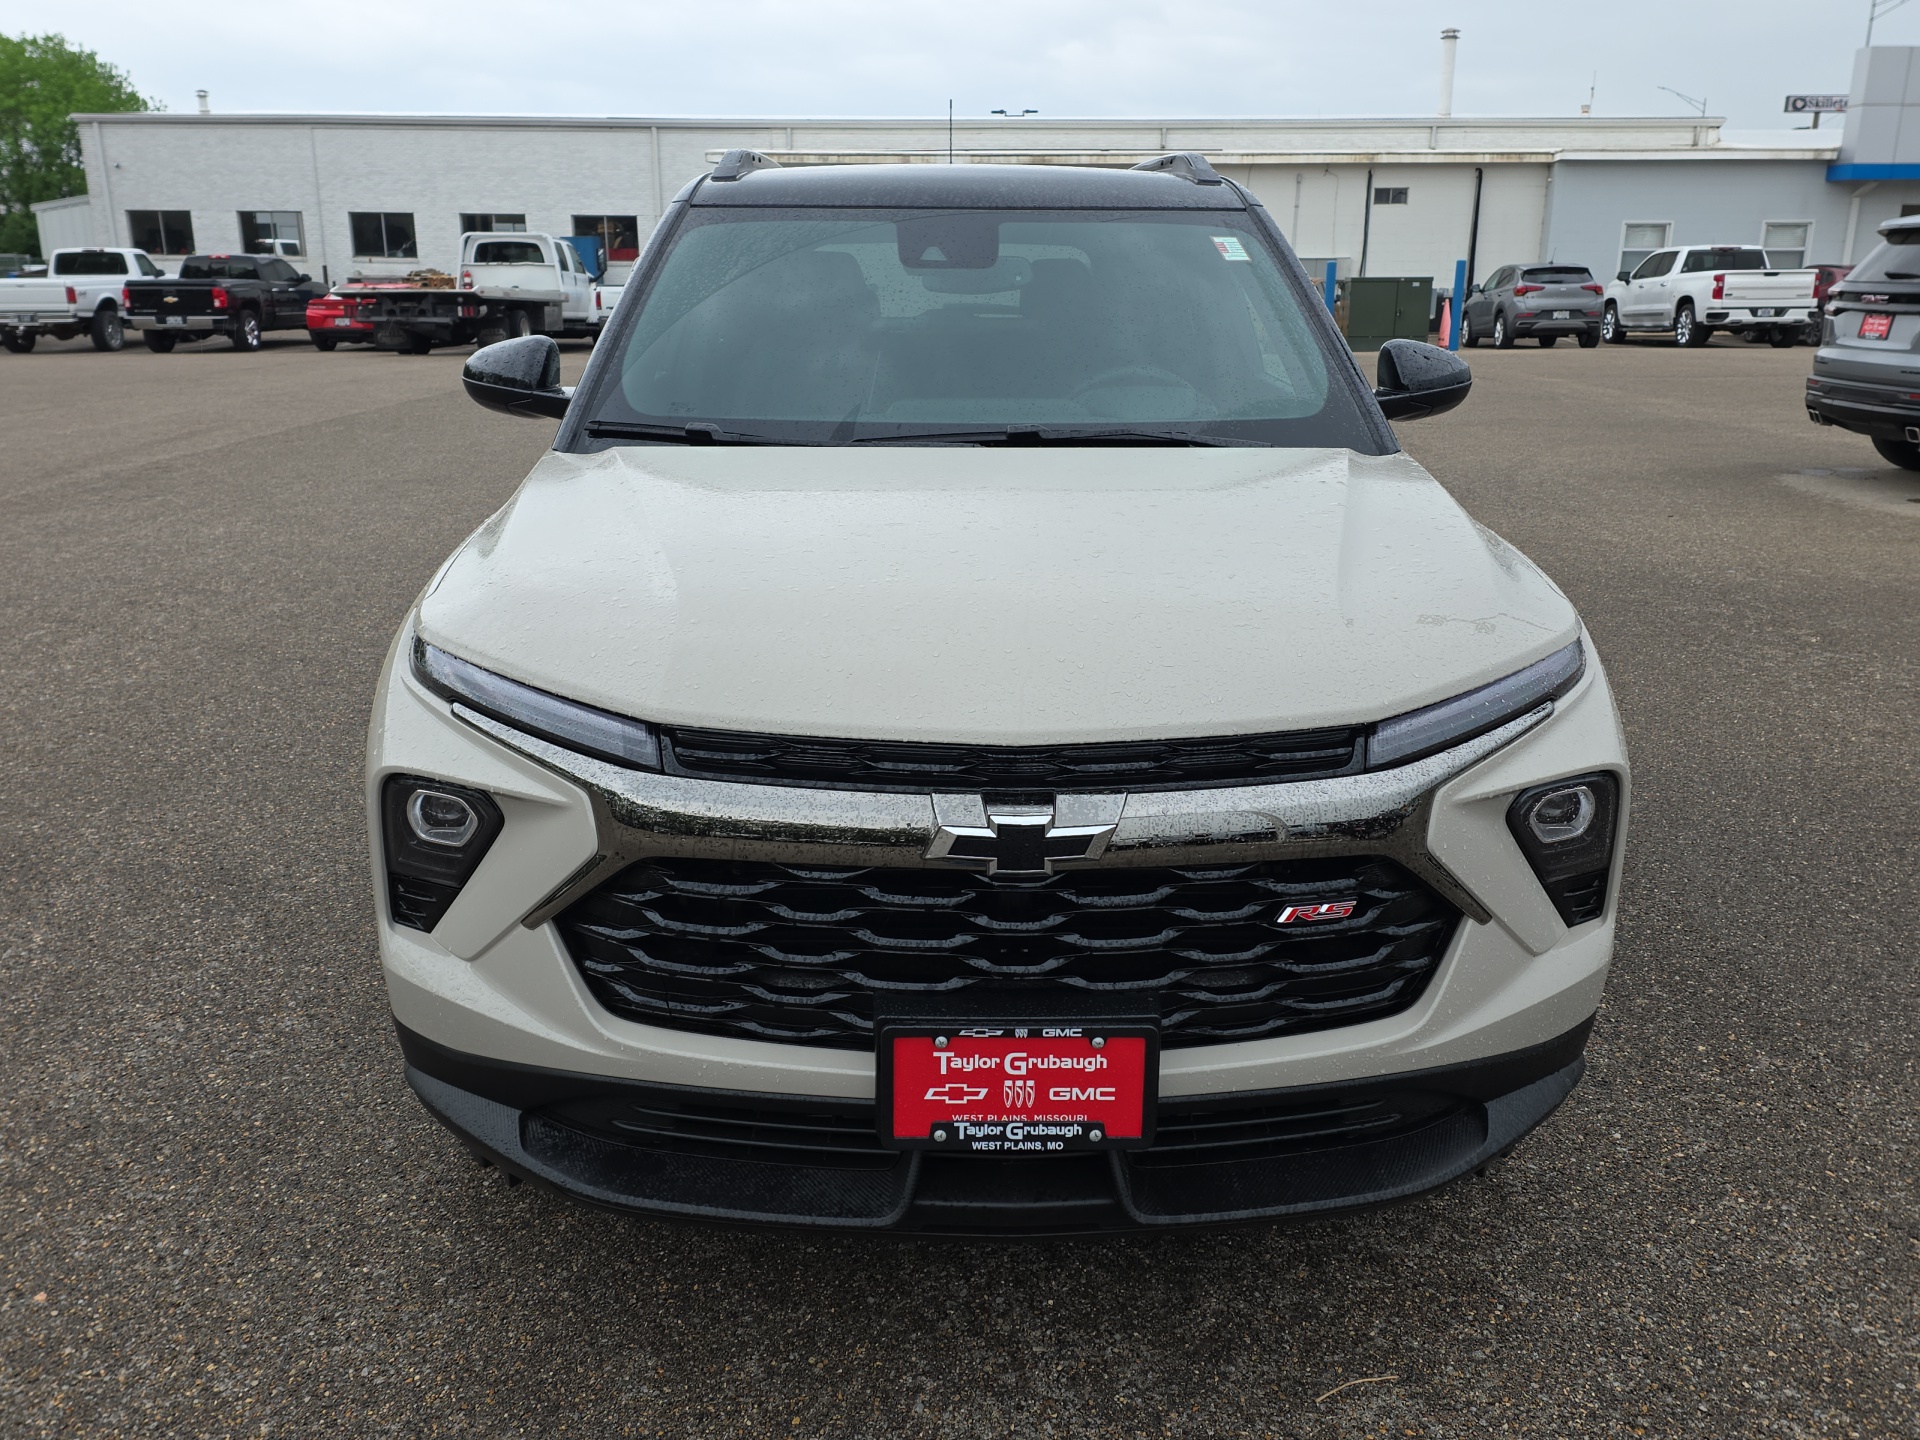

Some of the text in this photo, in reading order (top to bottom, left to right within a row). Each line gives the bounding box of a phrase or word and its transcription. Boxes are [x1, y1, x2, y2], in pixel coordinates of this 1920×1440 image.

[1277, 901, 1357, 923] RS
[1042, 1028, 1082, 1037] GMC
[933, 1052, 1108, 1075] Taylor Grubaugh
[1049, 1087, 1116, 1101] GMC
[952, 1114, 984, 1122] WEST
[1033, 1114, 1088, 1122] MISSOURI
[953, 1122, 1083, 1140] Taylor Grubaugh
[971, 1141, 1064, 1151] WEST PLAINS, MO
